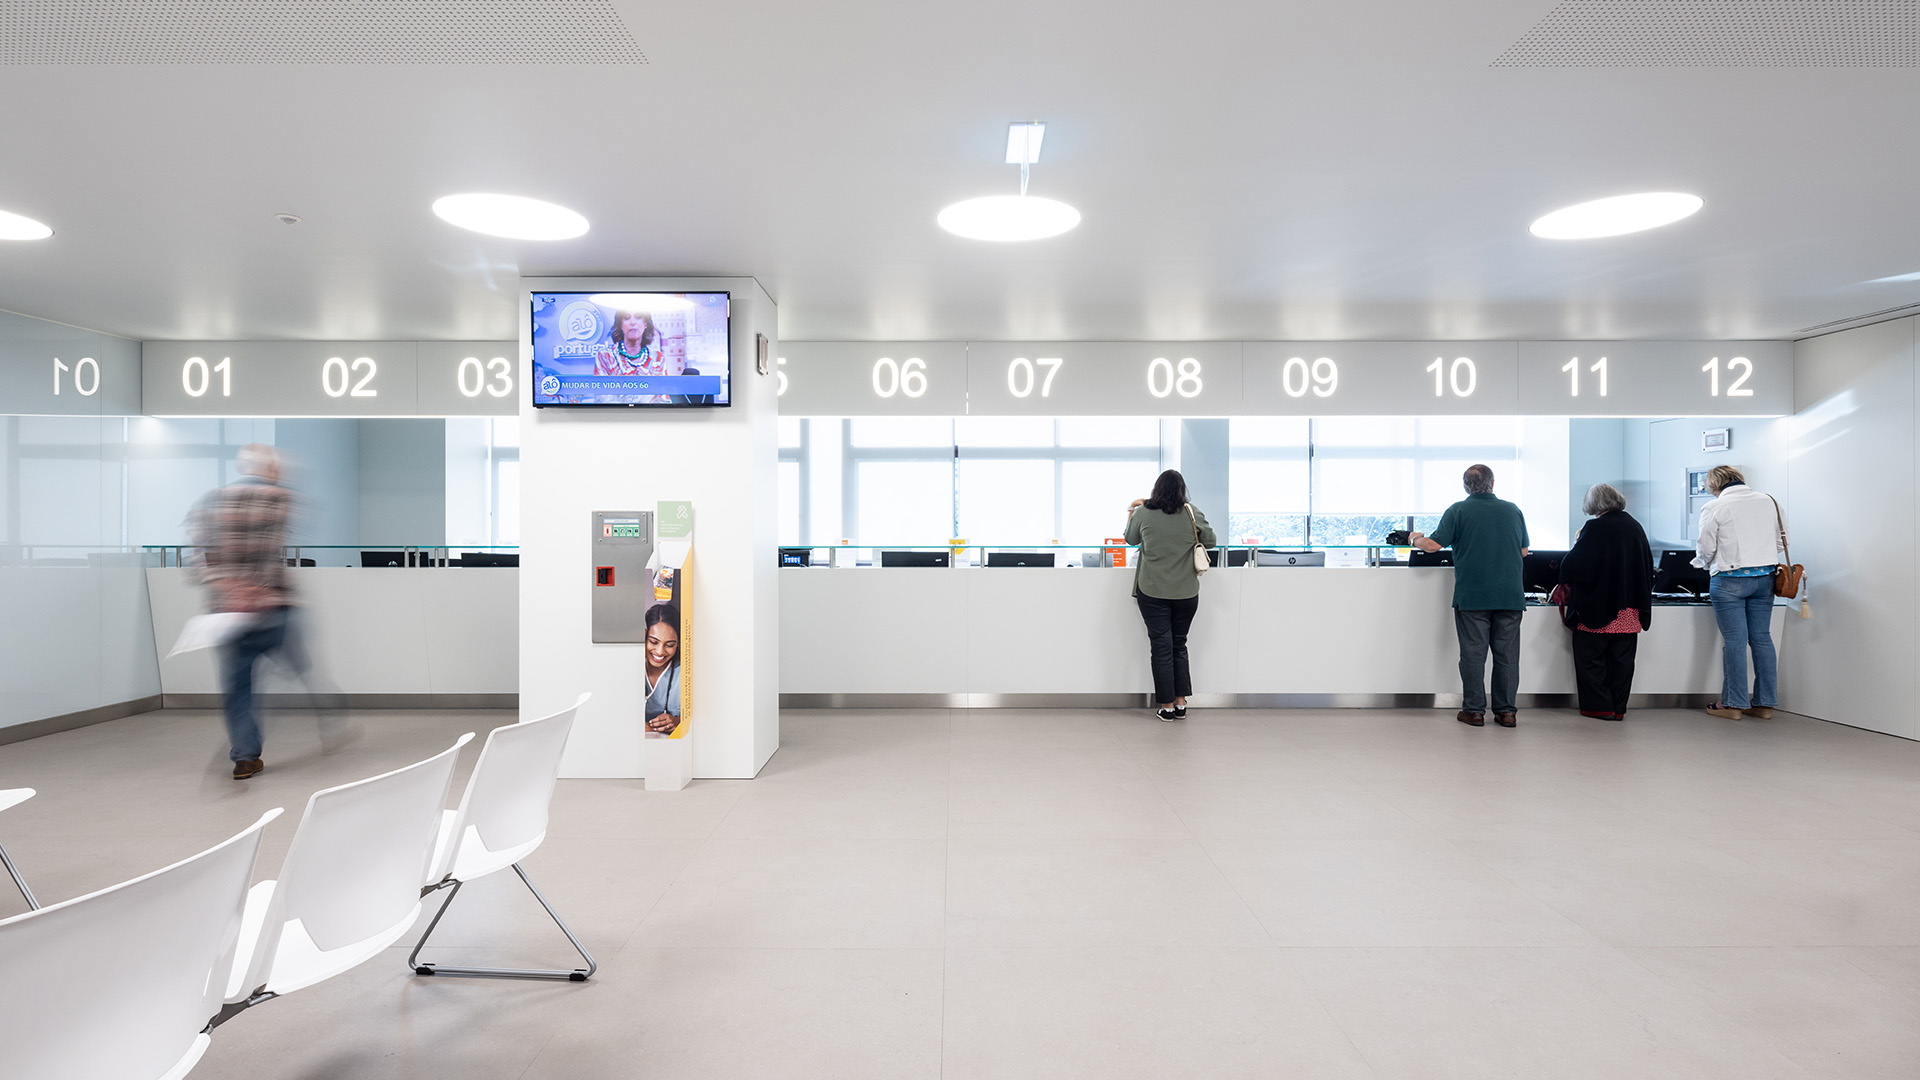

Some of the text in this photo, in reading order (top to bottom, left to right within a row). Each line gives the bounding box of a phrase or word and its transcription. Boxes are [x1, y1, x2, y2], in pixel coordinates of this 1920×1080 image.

[183, 357, 231, 397] 01
[323, 357, 377, 398] 02
[458, 357, 513, 398] 03
[872, 357, 928, 398] 06
[1007, 357, 1063, 398] 07
[1147, 357, 1203, 399] 08
[1283, 357, 1339, 399] 09
[1427, 357, 1477, 398] 10
[1562, 356, 1607, 397] 11
[1703, 356, 1754, 397] 12
